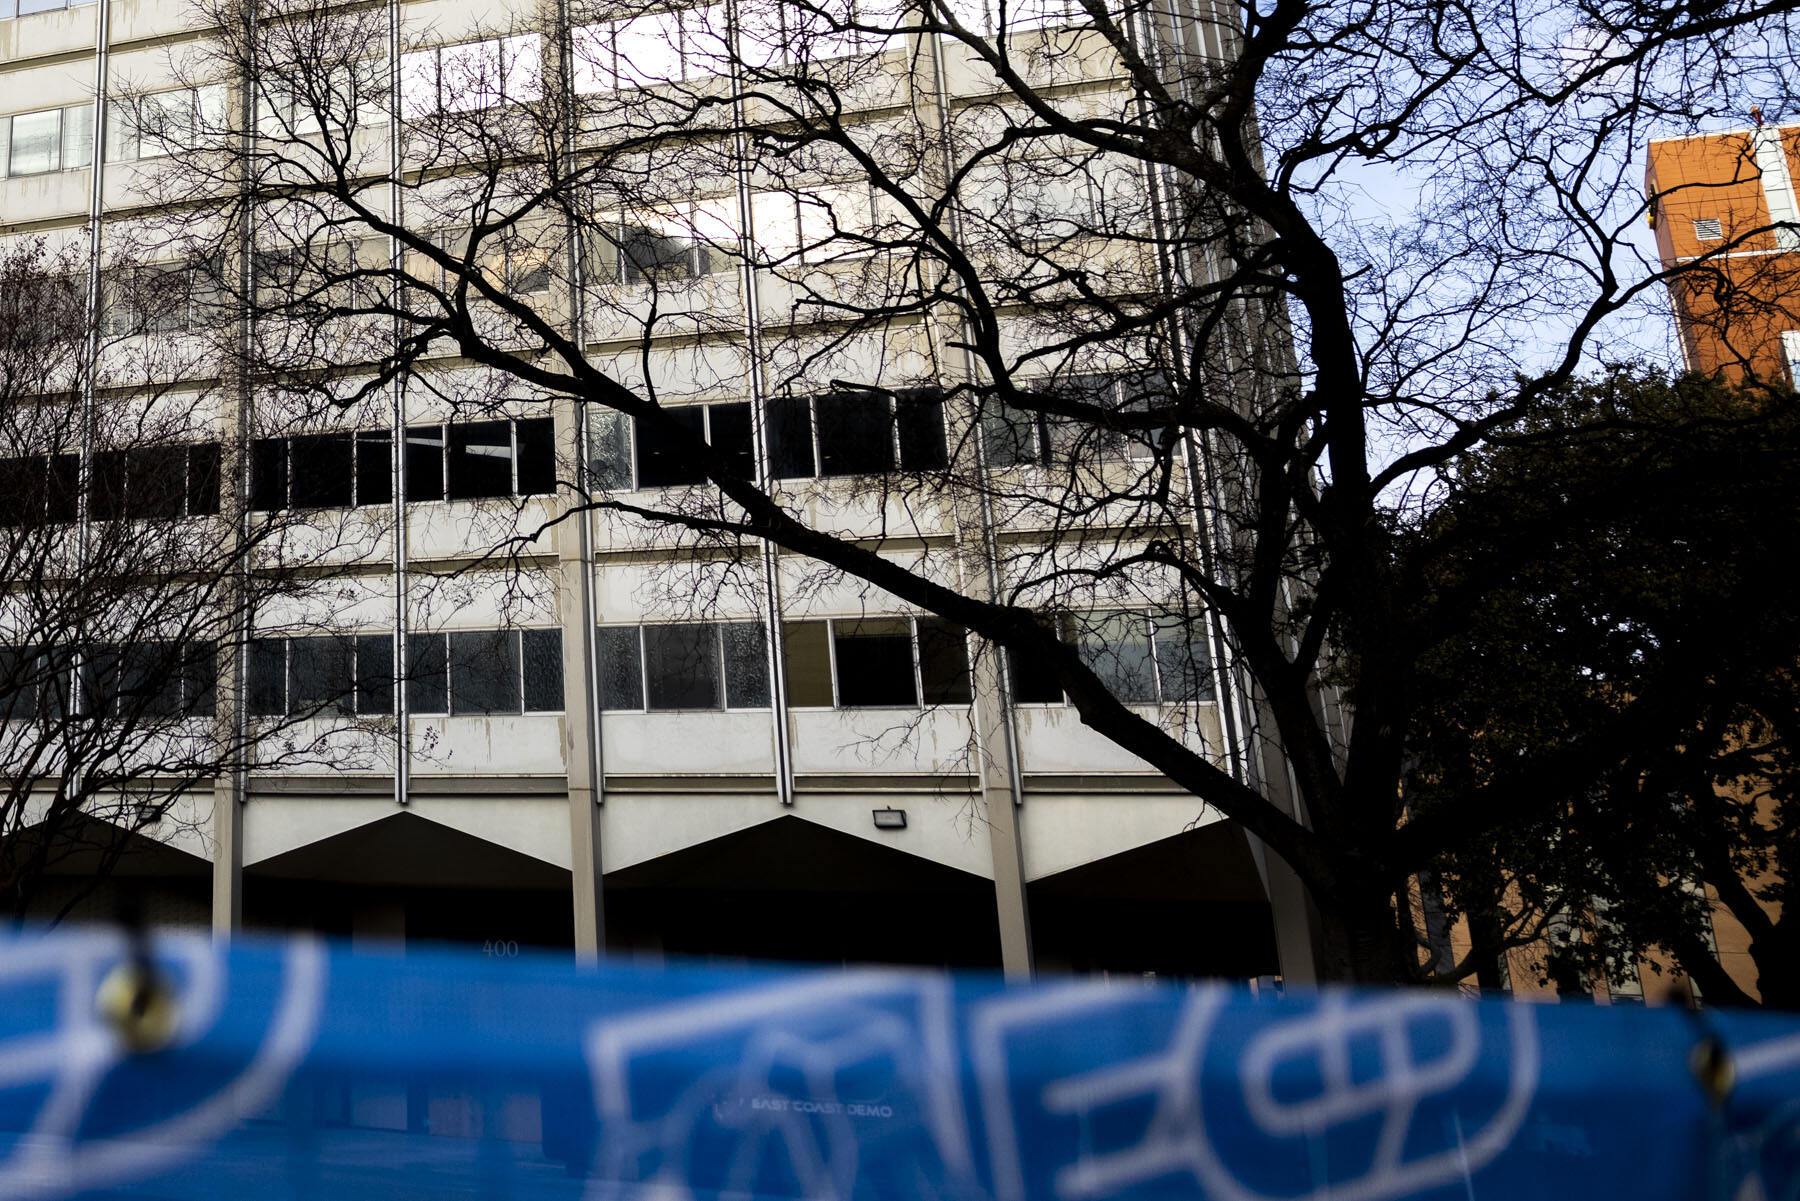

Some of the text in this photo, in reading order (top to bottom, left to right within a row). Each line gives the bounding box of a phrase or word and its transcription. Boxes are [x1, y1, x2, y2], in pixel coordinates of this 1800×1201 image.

[482, 939, 519, 957] 400
[751, 1098, 893, 1118] EAST COAST DEMO
